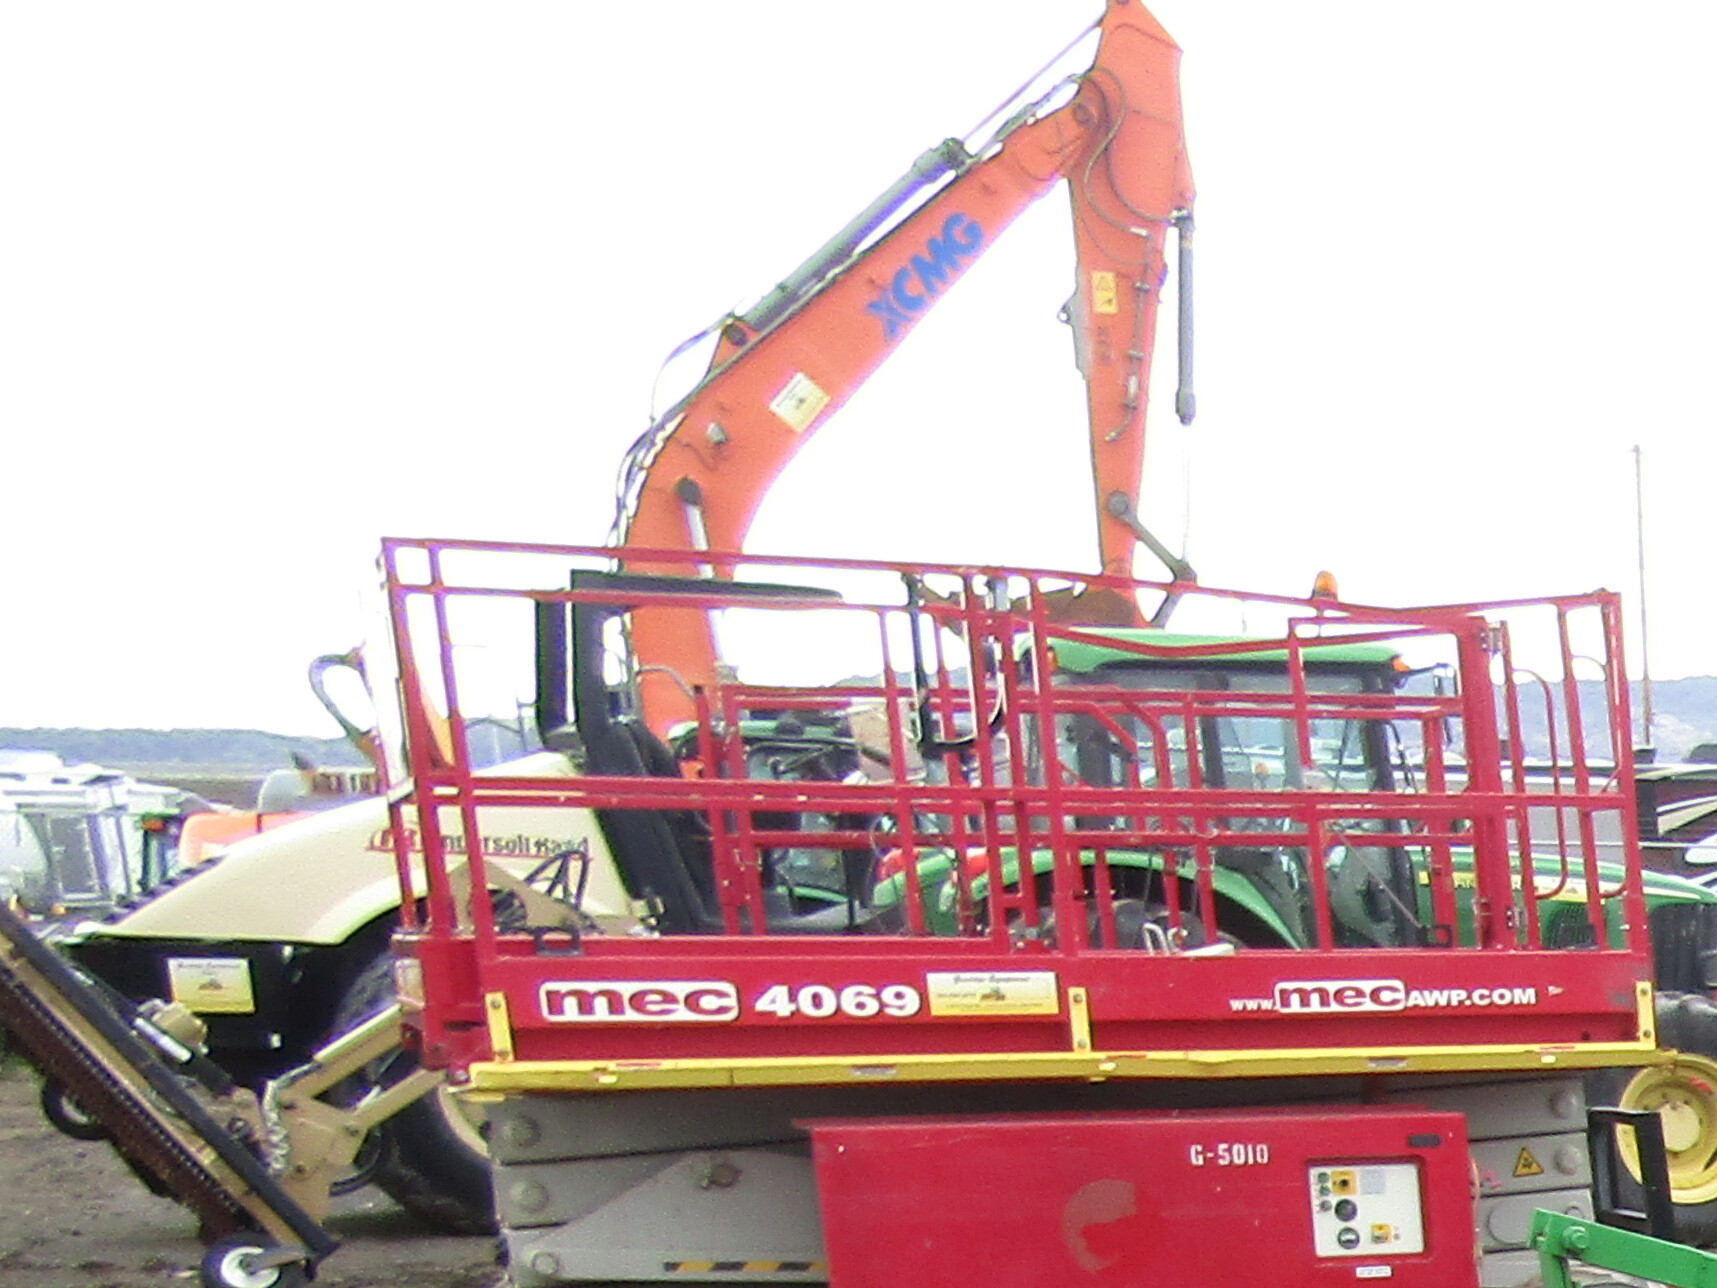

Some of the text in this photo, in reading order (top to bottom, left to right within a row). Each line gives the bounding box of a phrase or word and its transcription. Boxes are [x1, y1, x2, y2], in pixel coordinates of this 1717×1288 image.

[866, 213, 984, 341] XCMG
[542, 983, 921, 1020] mec 4069
[1190, 1143, 1270, 1166] G-5010
